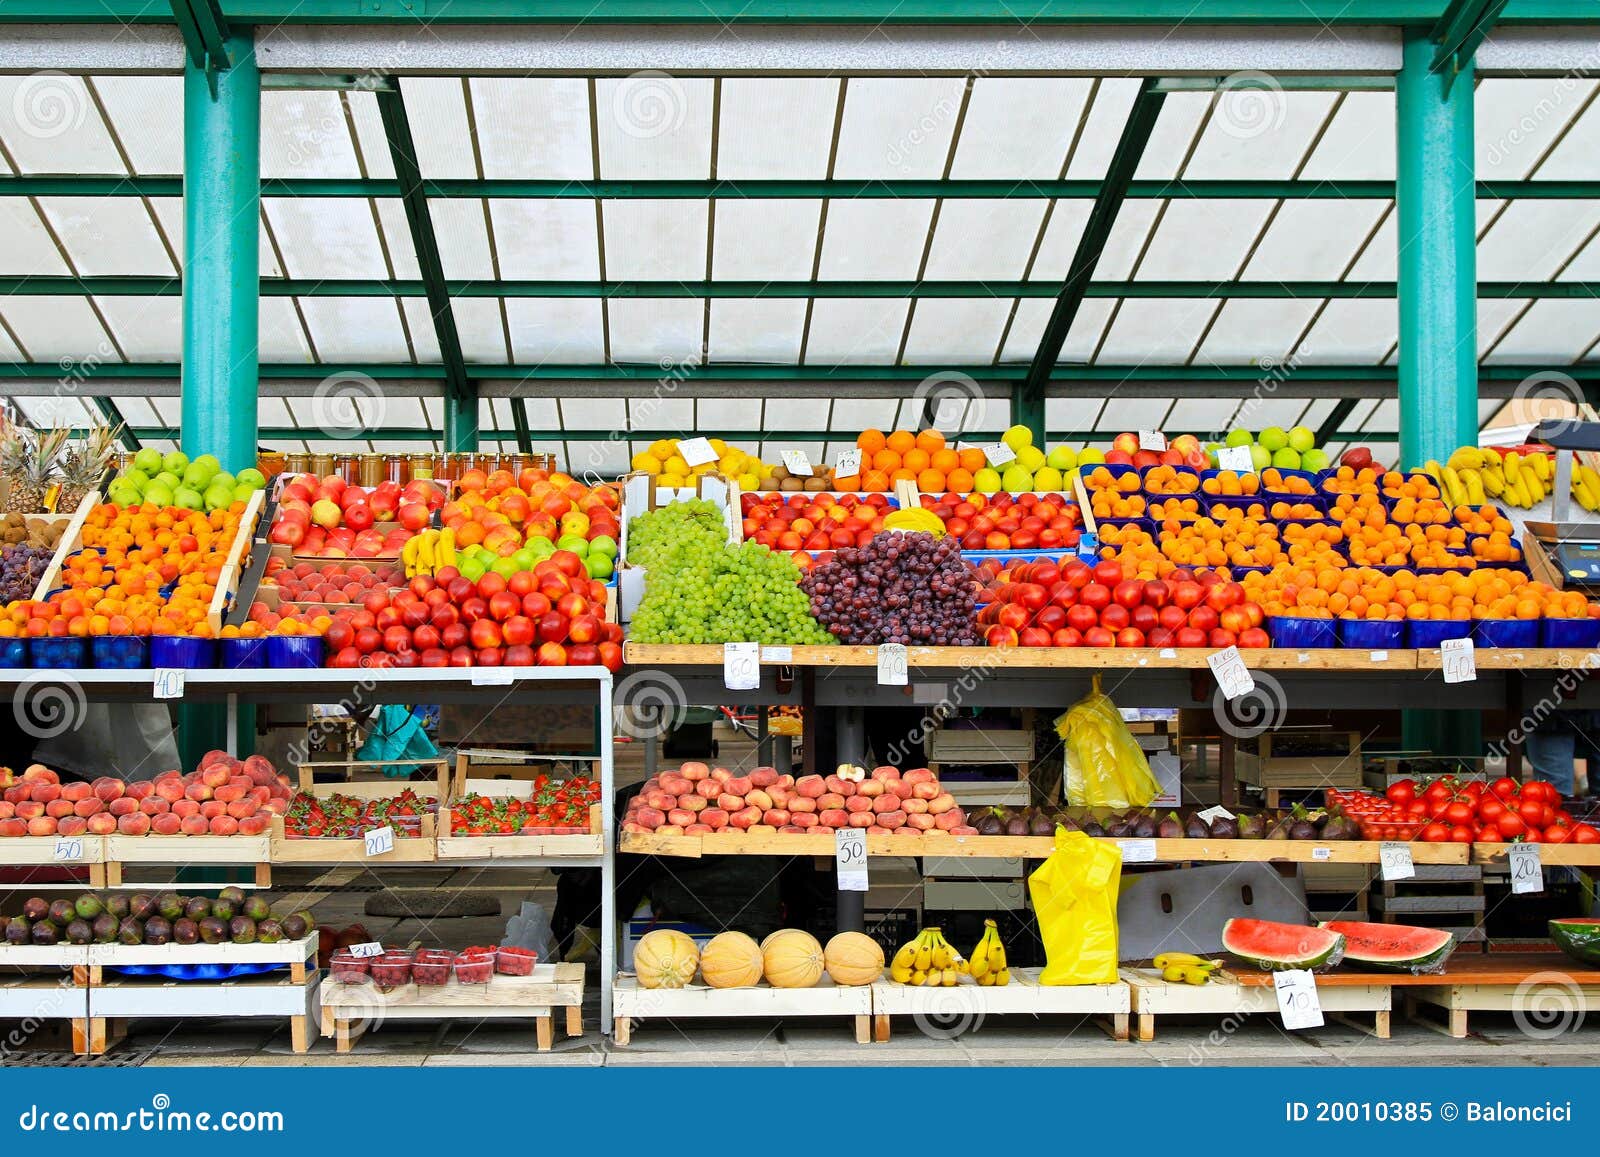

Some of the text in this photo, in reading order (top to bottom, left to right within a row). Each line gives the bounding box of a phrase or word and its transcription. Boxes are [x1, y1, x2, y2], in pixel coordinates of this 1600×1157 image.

[881, 652, 903, 681] 40
[1447, 655, 1469, 681] 40
[155, 670, 178, 697] 40
[56, 841, 81, 859] 50
[366, 836, 385, 855] 20
[841, 841, 863, 864] 50
[1514, 856, 1535, 879] 20
[1286, 992, 1310, 1007] 10
